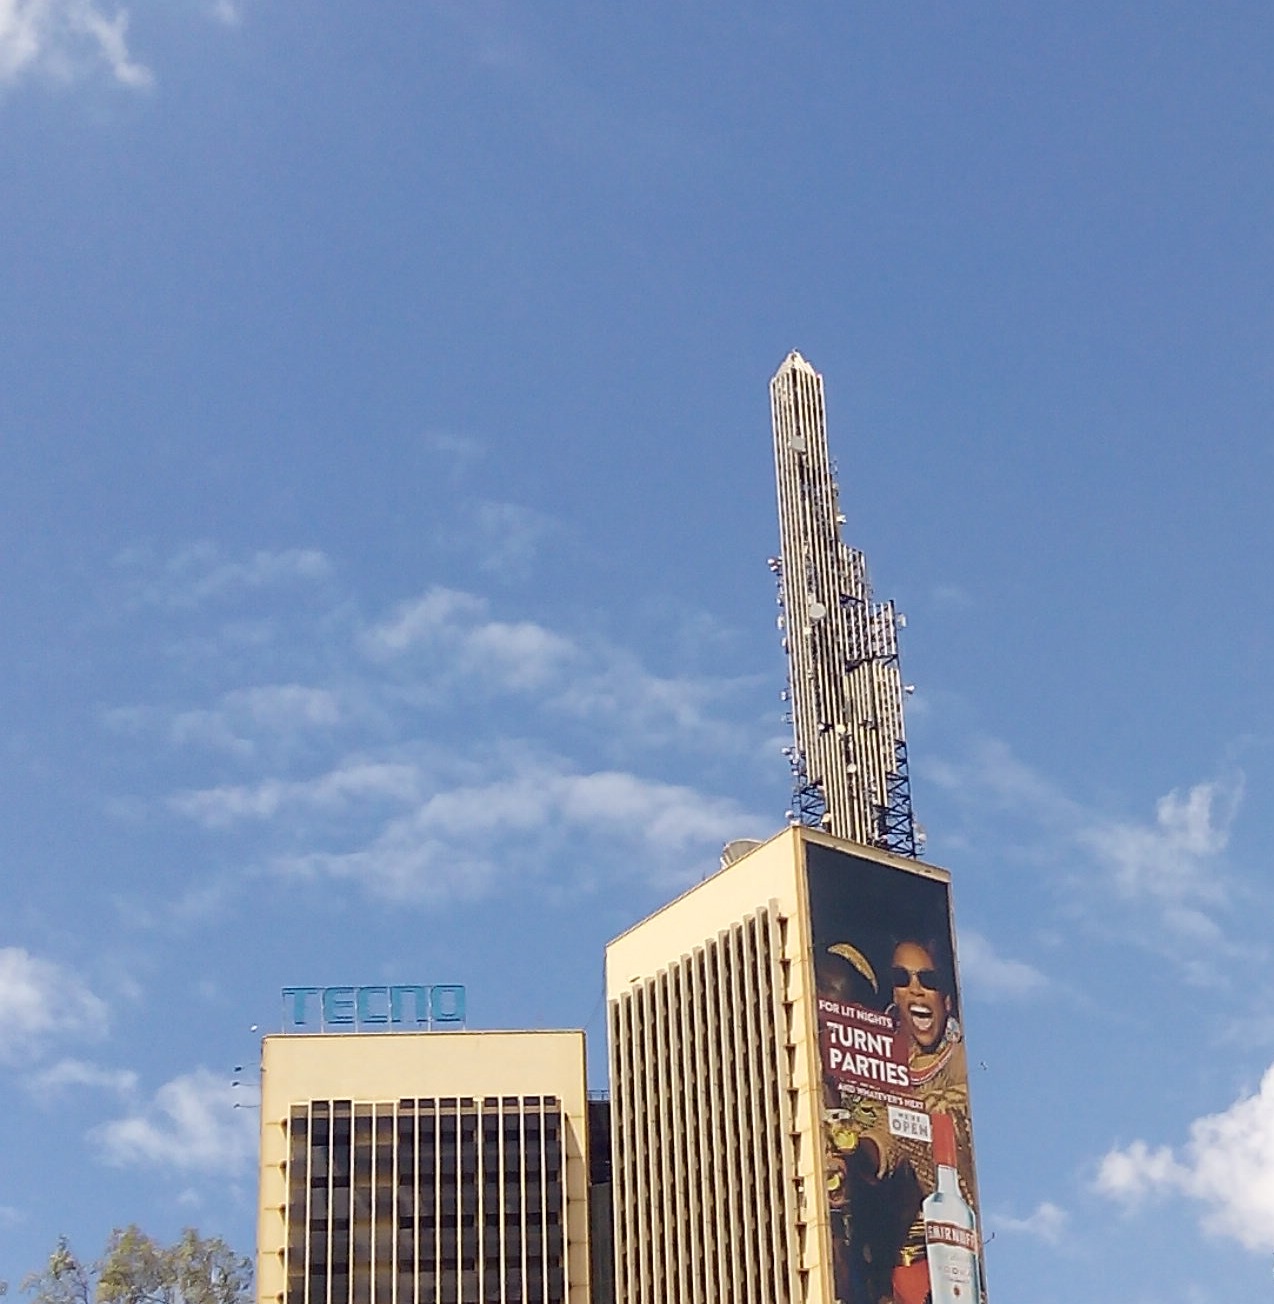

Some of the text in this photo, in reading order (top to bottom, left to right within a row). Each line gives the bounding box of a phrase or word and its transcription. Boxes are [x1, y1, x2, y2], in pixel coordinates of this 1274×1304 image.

[282, 985, 466, 1024] TECNO
[819, 1000, 893, 1028] FOR LIT NIGHTS
[826, 1021, 893, 1058] TURNT
[829, 1048, 910, 1087] PARTIES
[892, 1118, 928, 1137] OPEN
